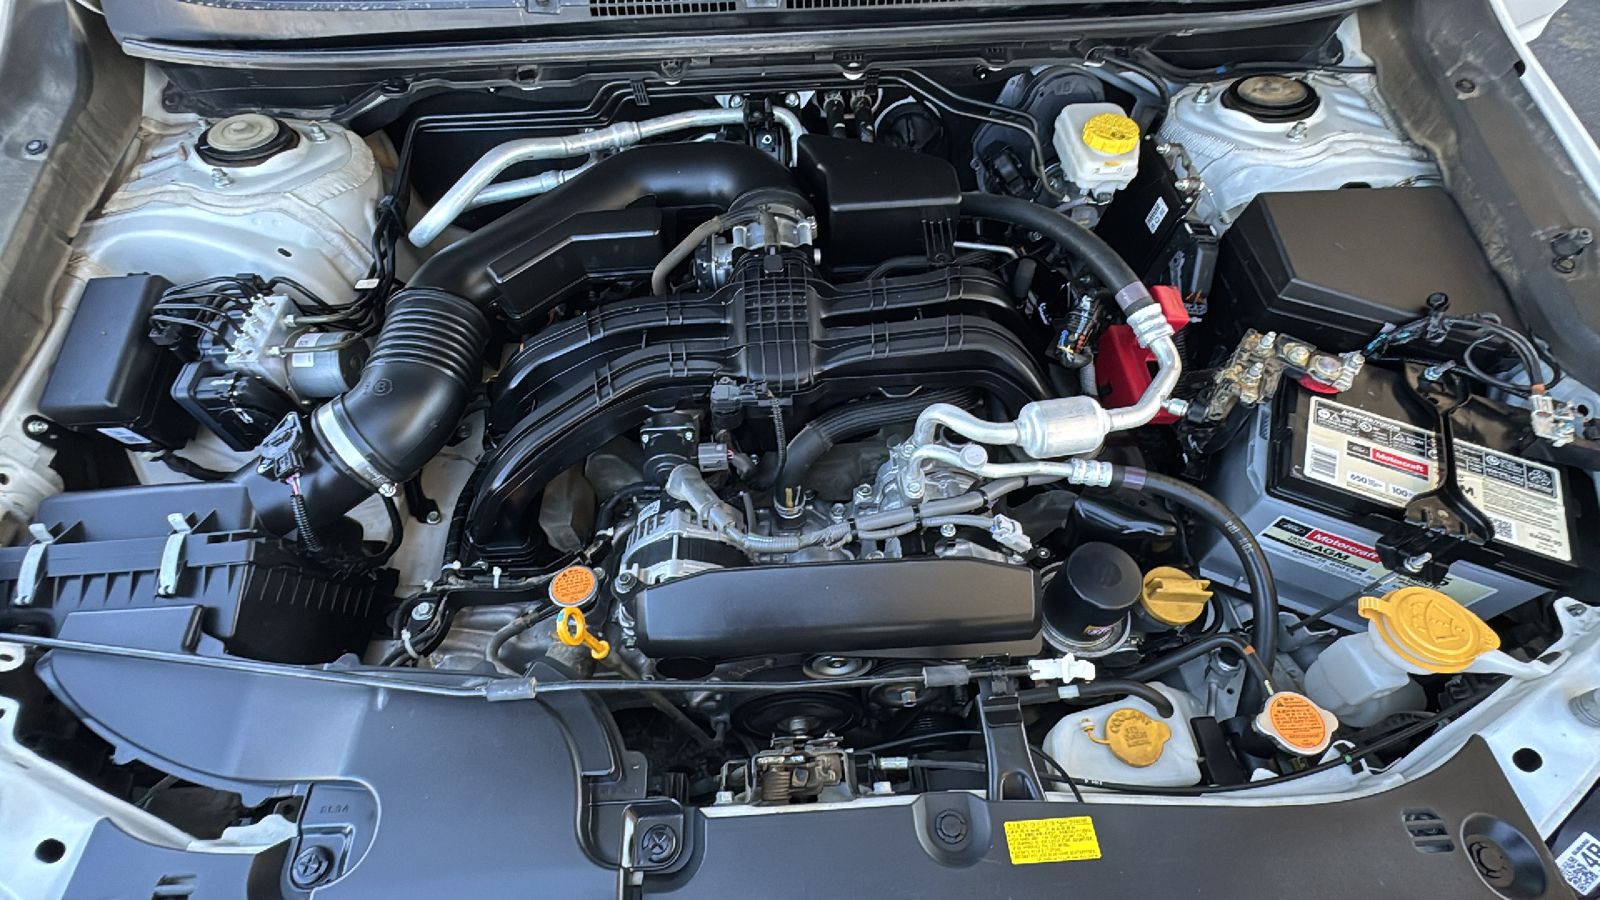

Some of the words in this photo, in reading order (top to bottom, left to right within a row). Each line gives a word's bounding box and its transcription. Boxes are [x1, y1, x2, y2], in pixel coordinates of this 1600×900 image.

[1374, 451, 1425, 473] Motorcraft
[1391, 485, 1408, 497] 100
[1311, 545, 1351, 561] AGM
[1312, 533, 1379, 560] Motorcraft
